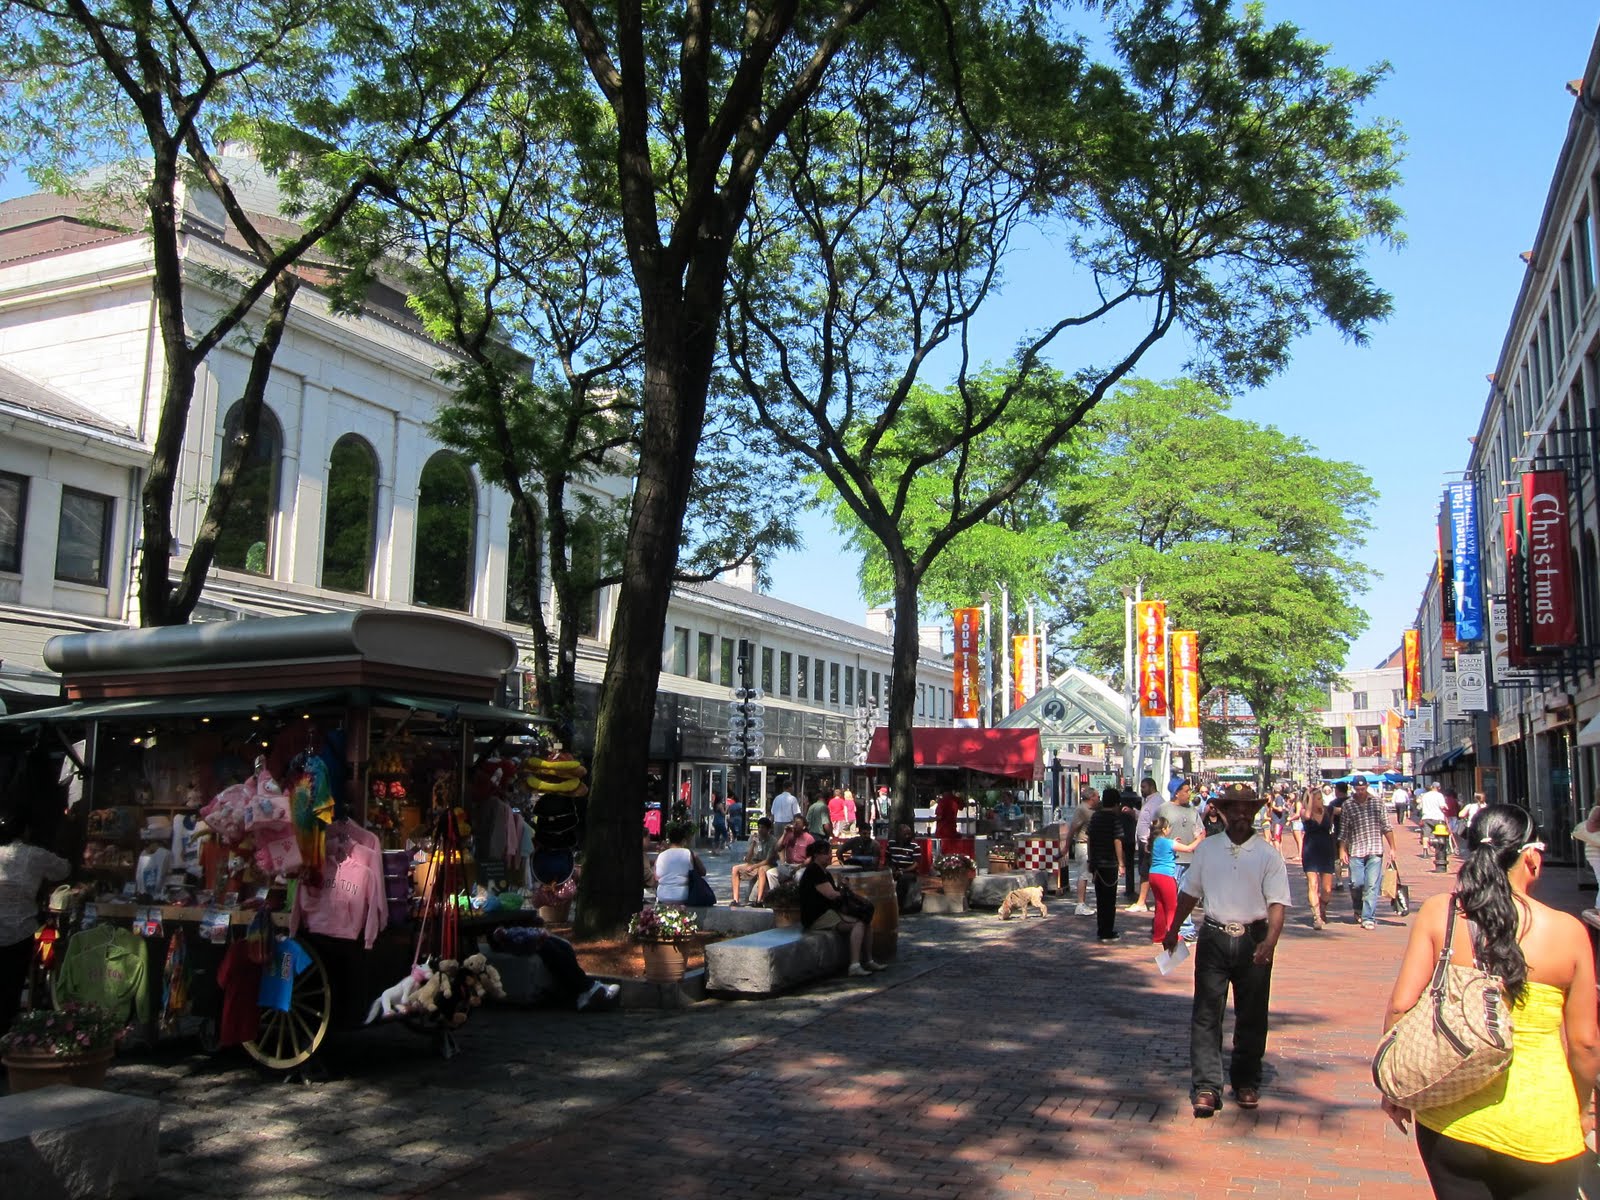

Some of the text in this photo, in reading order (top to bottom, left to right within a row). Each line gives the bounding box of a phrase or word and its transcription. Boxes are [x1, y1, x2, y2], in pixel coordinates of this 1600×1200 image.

[1451, 485, 1466, 555] Faneuil Hall
[1464, 485, 1475, 555] MARKETPLACE
[1528, 493, 1564, 625] Christmas
[962, 614, 970, 712] TOUR TICKETS
[1147, 607, 1159, 710] INFORMATION
